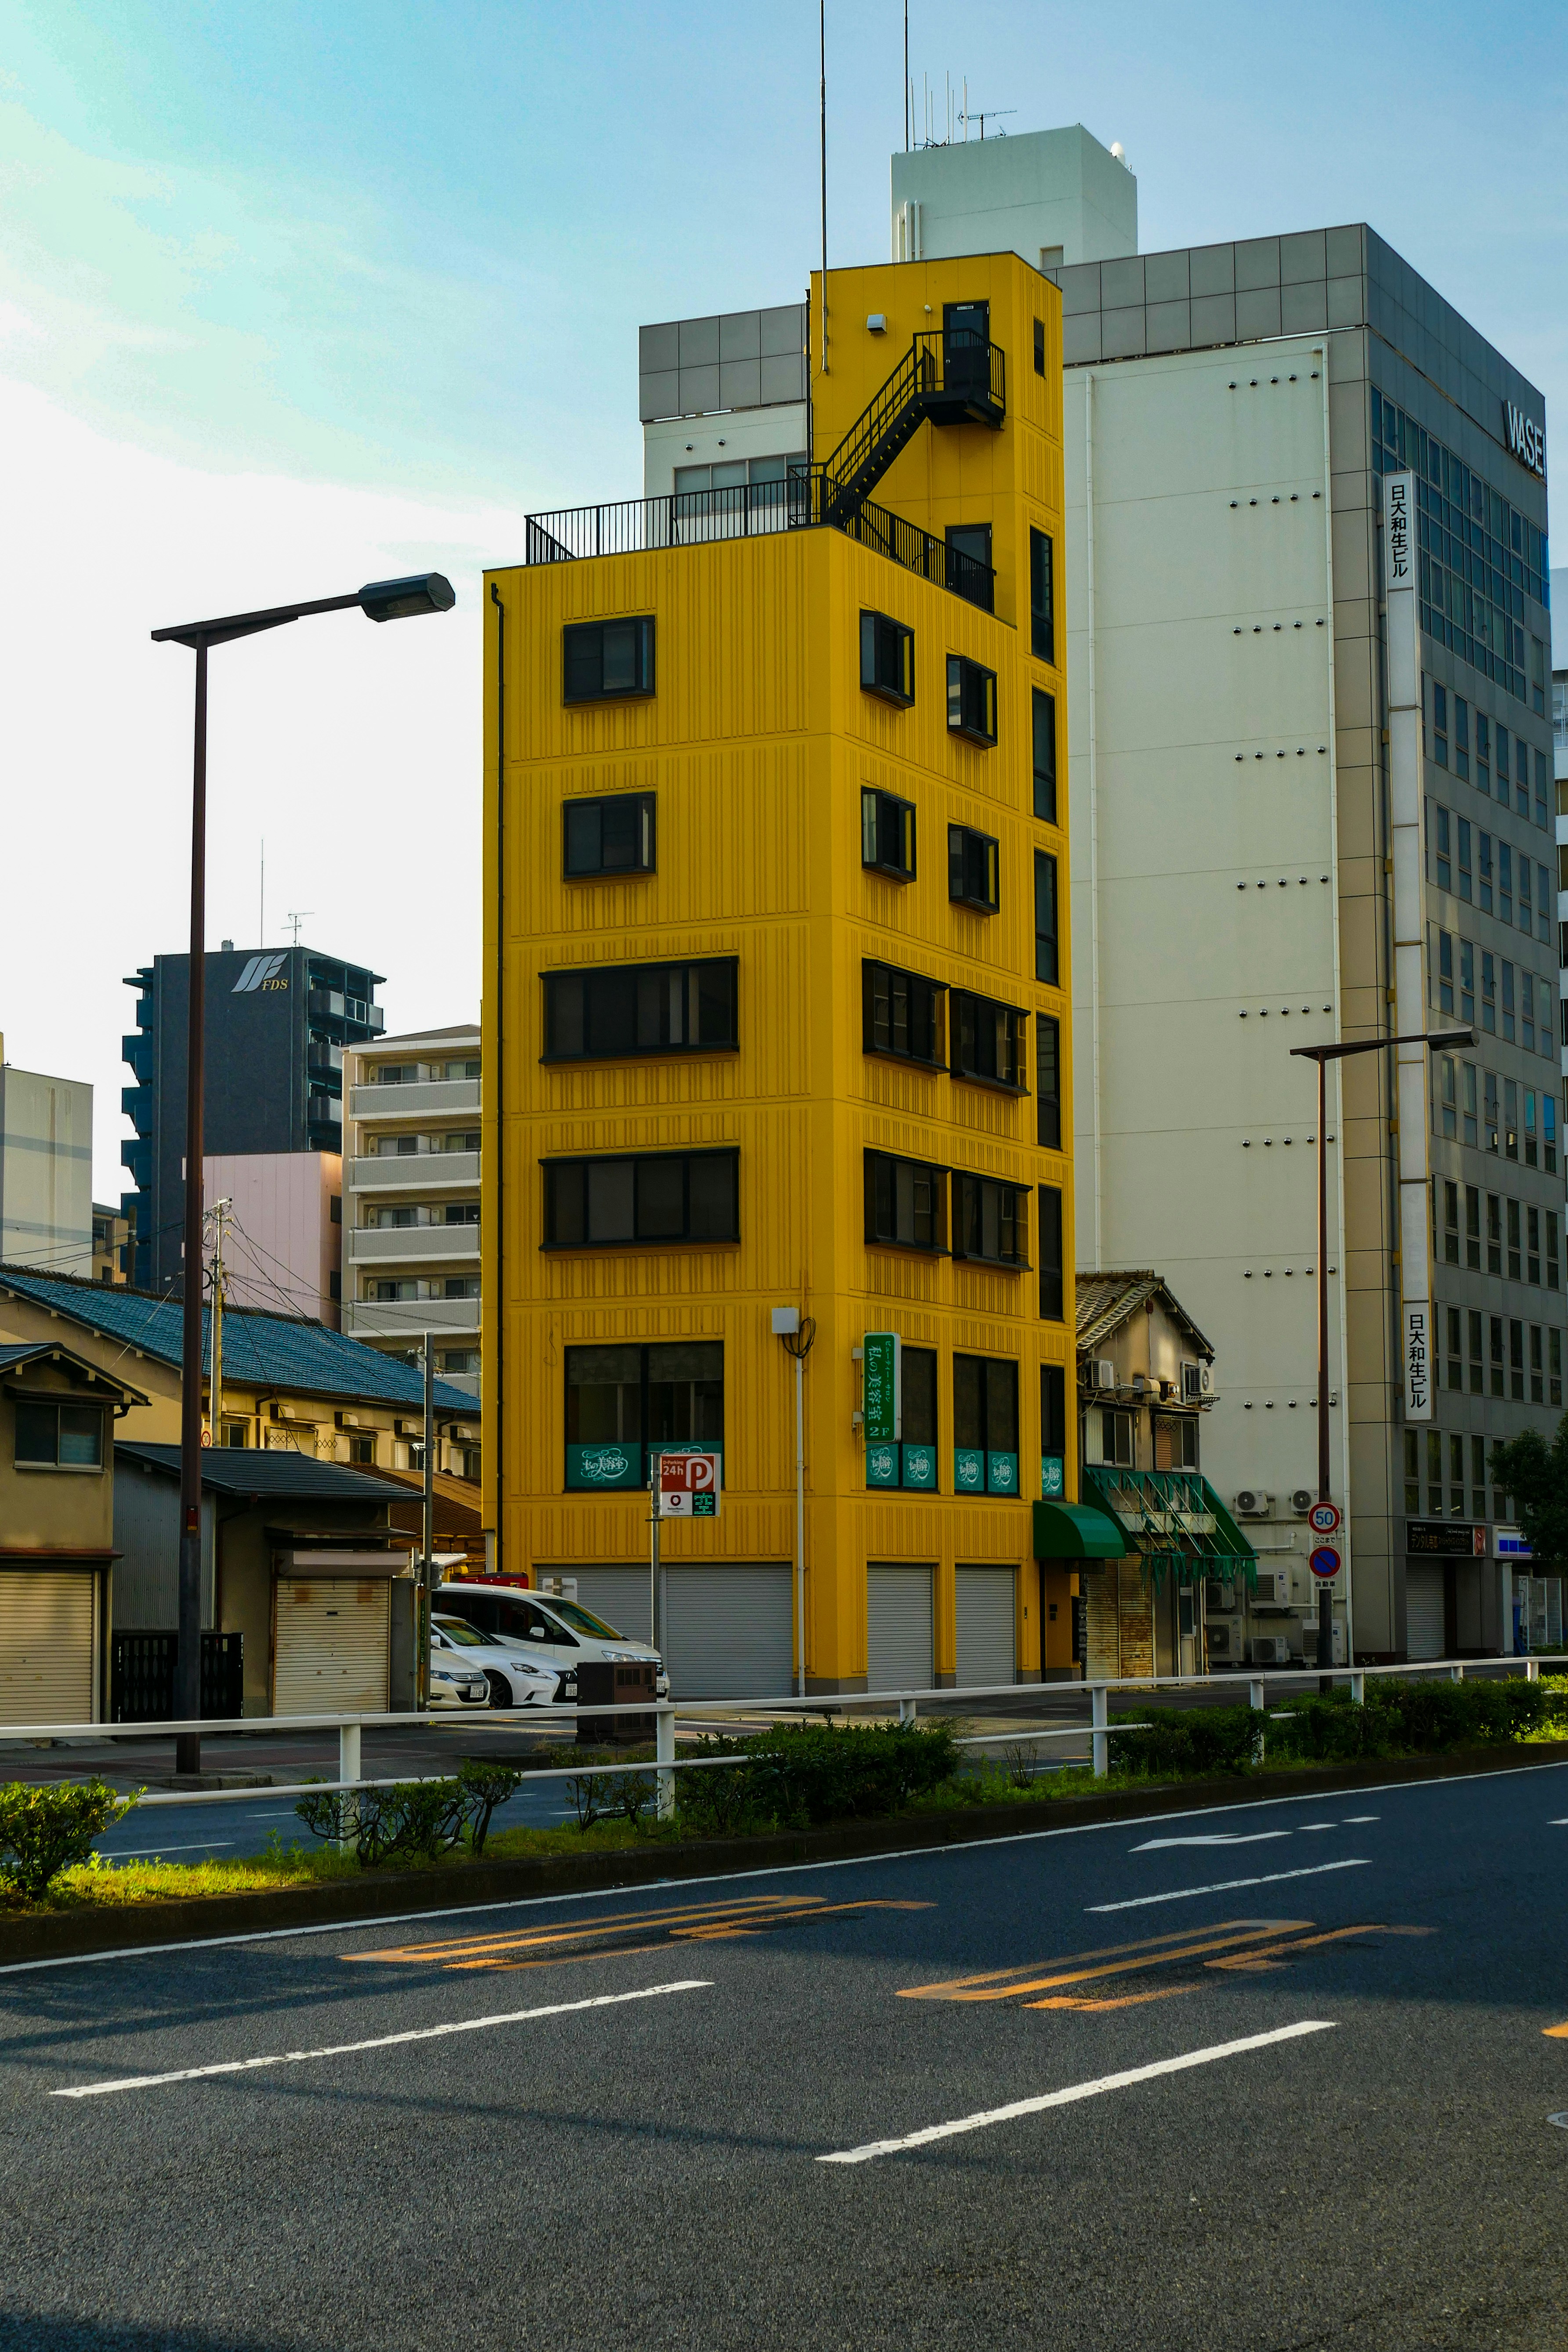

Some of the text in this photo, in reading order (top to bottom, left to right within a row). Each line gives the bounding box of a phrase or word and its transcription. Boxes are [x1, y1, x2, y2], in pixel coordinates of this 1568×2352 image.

[1506, 399, 1546, 478] WASEI
[1391, 484, 1409, 578] 日大和生ビル
[261, 979, 288, 991] FDS
[868, 1345, 882, 1421] 私の美容室
[1409, 1314, 1427, 1409] 日大和生ビル
[663, 1465, 684, 1475] 24h
[1316, 1511, 1333, 1525] 50
